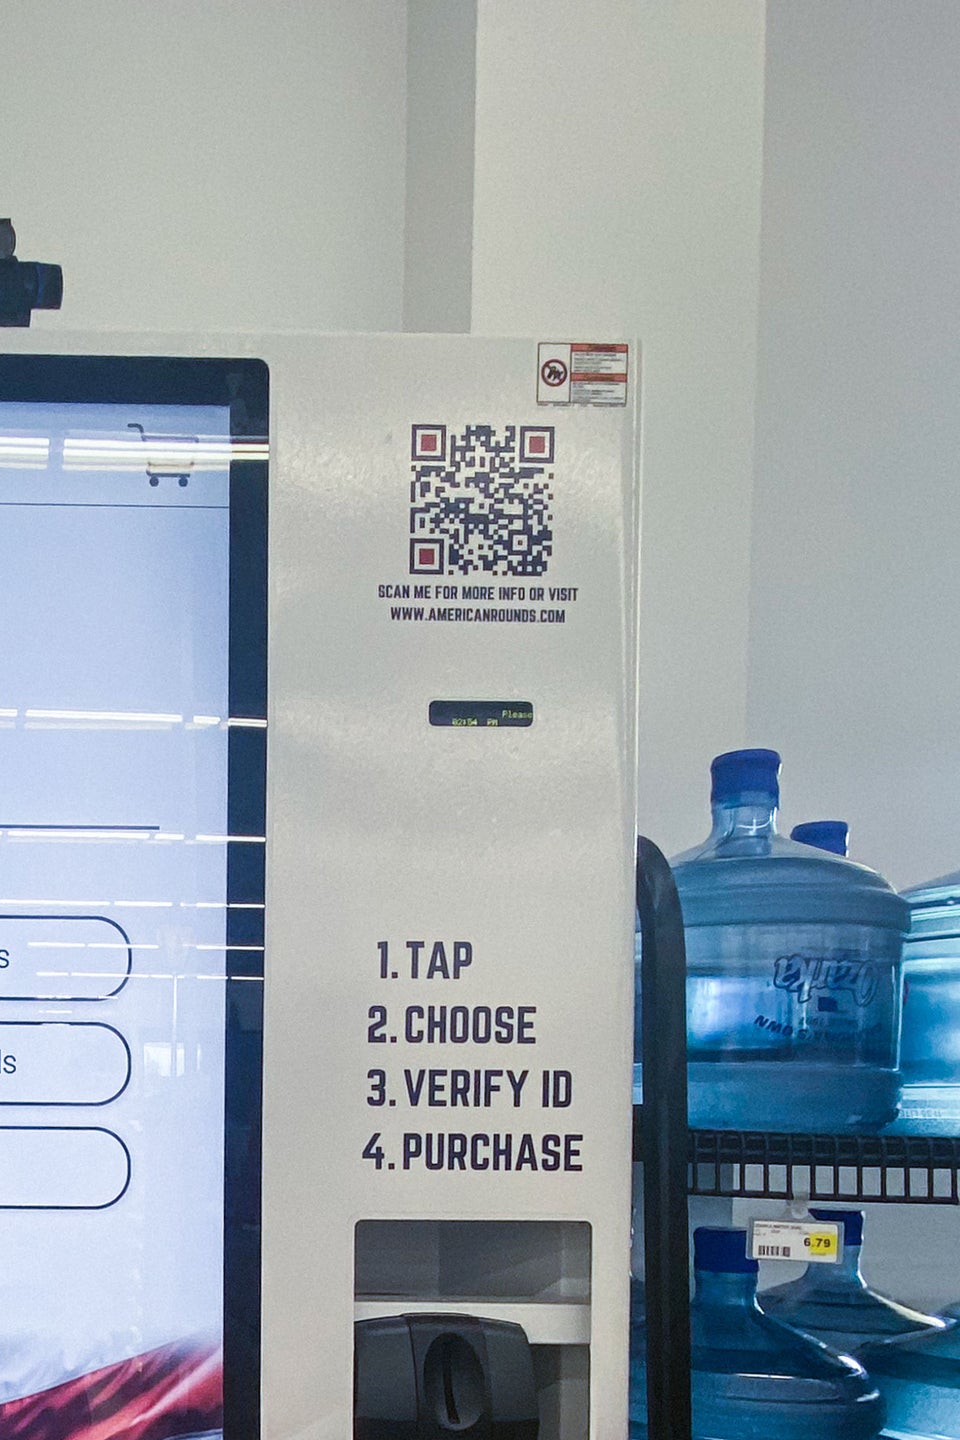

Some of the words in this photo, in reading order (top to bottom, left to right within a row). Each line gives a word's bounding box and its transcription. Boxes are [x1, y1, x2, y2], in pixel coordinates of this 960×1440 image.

[378, 584, 410, 599] SCAN
[414, 585, 431, 599] ME
[435, 585, 458, 600] FOR
[462, 586, 495, 600] MORE
[498, 587, 525, 601] INFO
[529, 587, 544, 601] OR
[548, 587, 579, 602] VISIT
[390, 607, 566, 623] WWW.AMERICANROUNDS.COM
[542, 1070, 572, 1108] ID
[804, 1237, 831, 1248] 6.79
